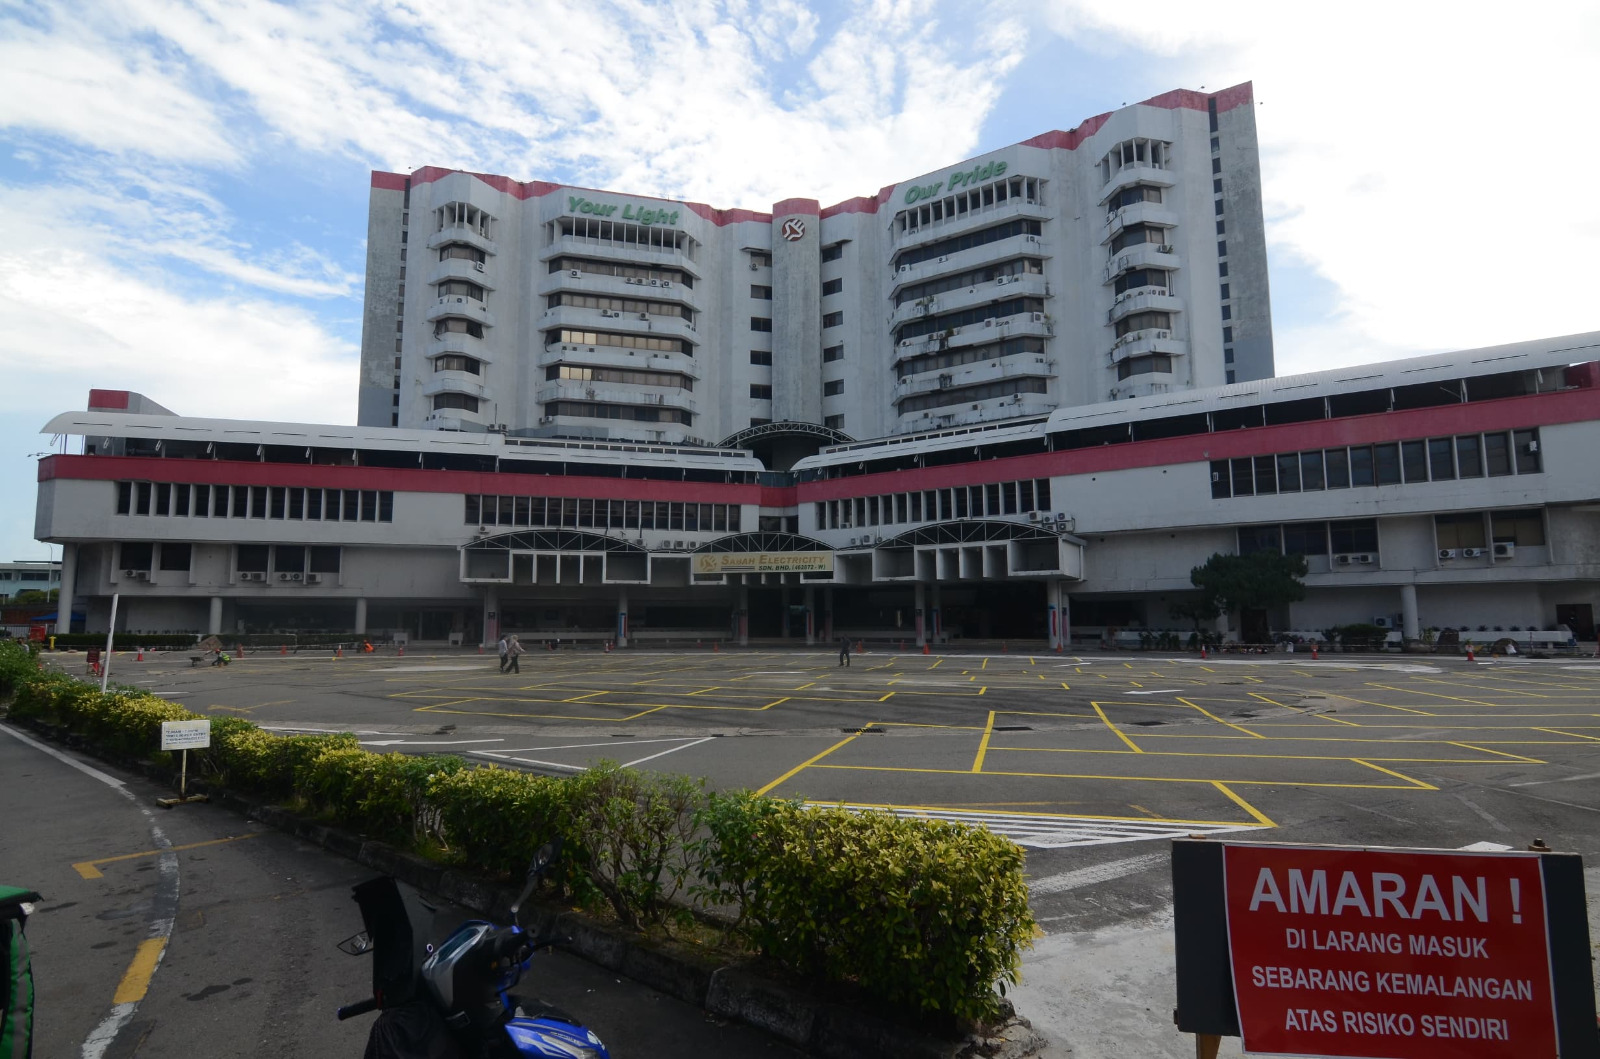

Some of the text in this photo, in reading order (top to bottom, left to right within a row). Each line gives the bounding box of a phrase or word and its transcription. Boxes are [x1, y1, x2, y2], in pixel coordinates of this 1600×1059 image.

[904, 161, 1008, 204] Our Pride
[568, 196, 679, 225] Your Light
[758, 554, 825, 565] ELECTRICITY
[1249, 867, 1522, 924] AMARAN !
[1286, 928, 1489, 959] DI LARANG MASUK
[1252, 965, 1532, 1001] SEBARANG KEMALANGAN
[1285, 1008, 1509, 1040] ATAS RISIKO SENDIRI
